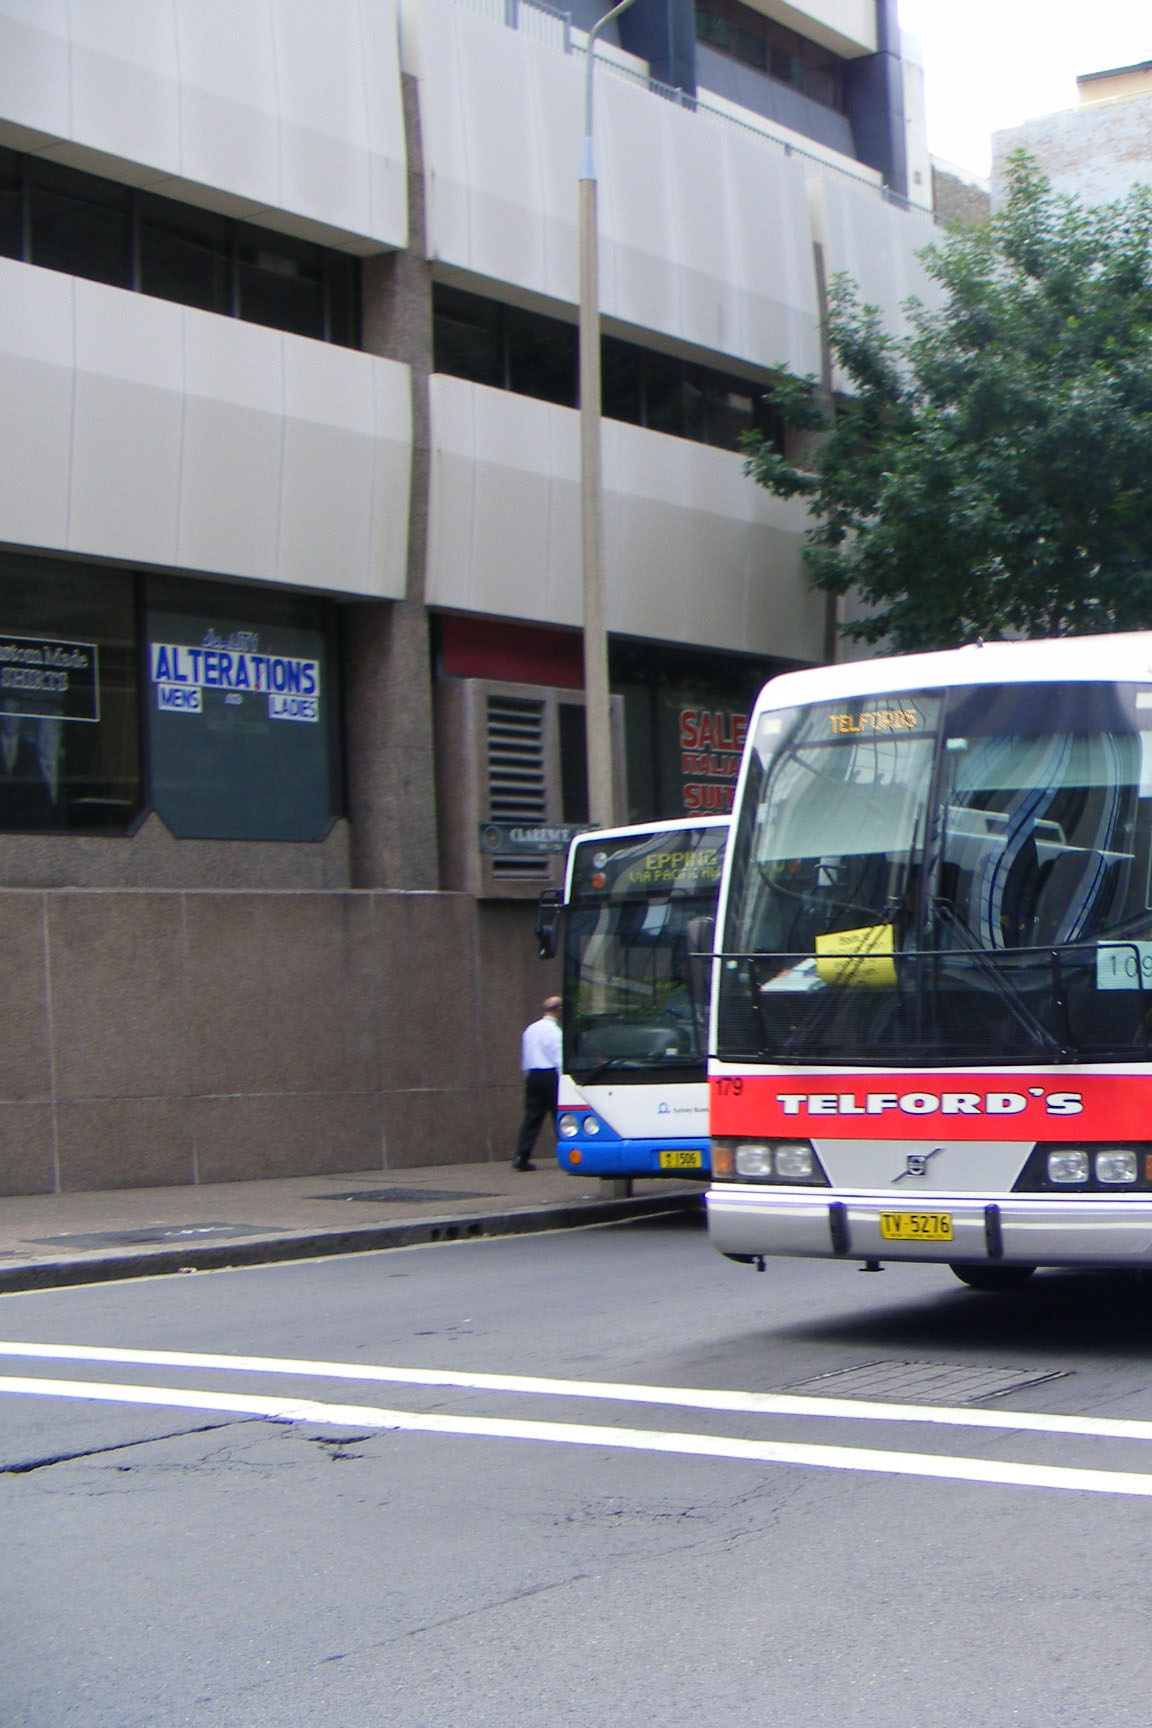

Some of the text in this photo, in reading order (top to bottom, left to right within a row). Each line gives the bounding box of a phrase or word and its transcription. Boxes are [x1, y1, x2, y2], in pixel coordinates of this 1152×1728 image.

[156, 645, 316, 695] ALTERATIONS
[161, 687, 200, 710] MENS
[271, 696, 317, 719] LADIES
[680, 709, 747, 752] SALE
[646, 849, 718, 870] EPPING
[716, 1077, 744, 1097] 179
[775, 1086, 1085, 1116] TELFORD'S
